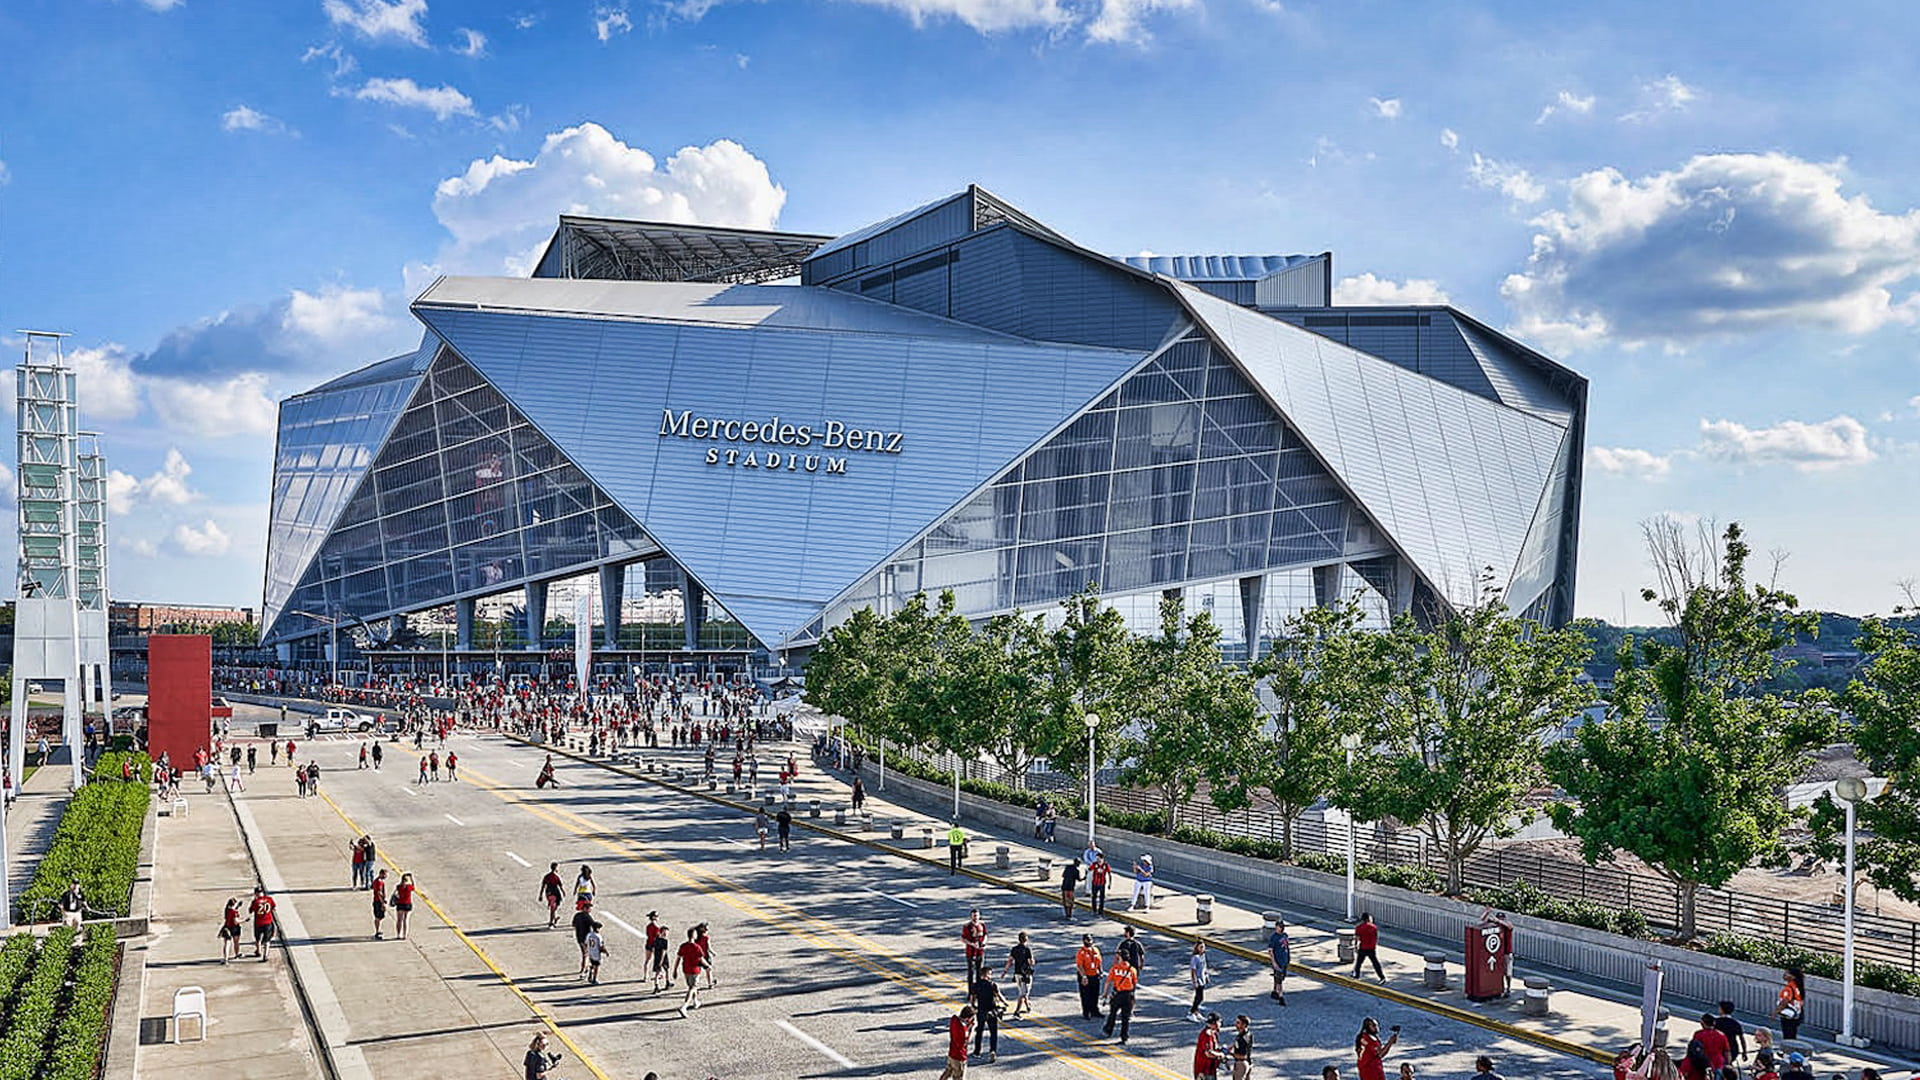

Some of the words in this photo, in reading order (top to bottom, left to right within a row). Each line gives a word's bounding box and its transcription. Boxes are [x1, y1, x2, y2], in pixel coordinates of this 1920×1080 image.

[659, 409, 904, 453] Mercedes-Benz
[706, 447, 847, 473] STADIUM
[256, 902, 271, 915] 20
